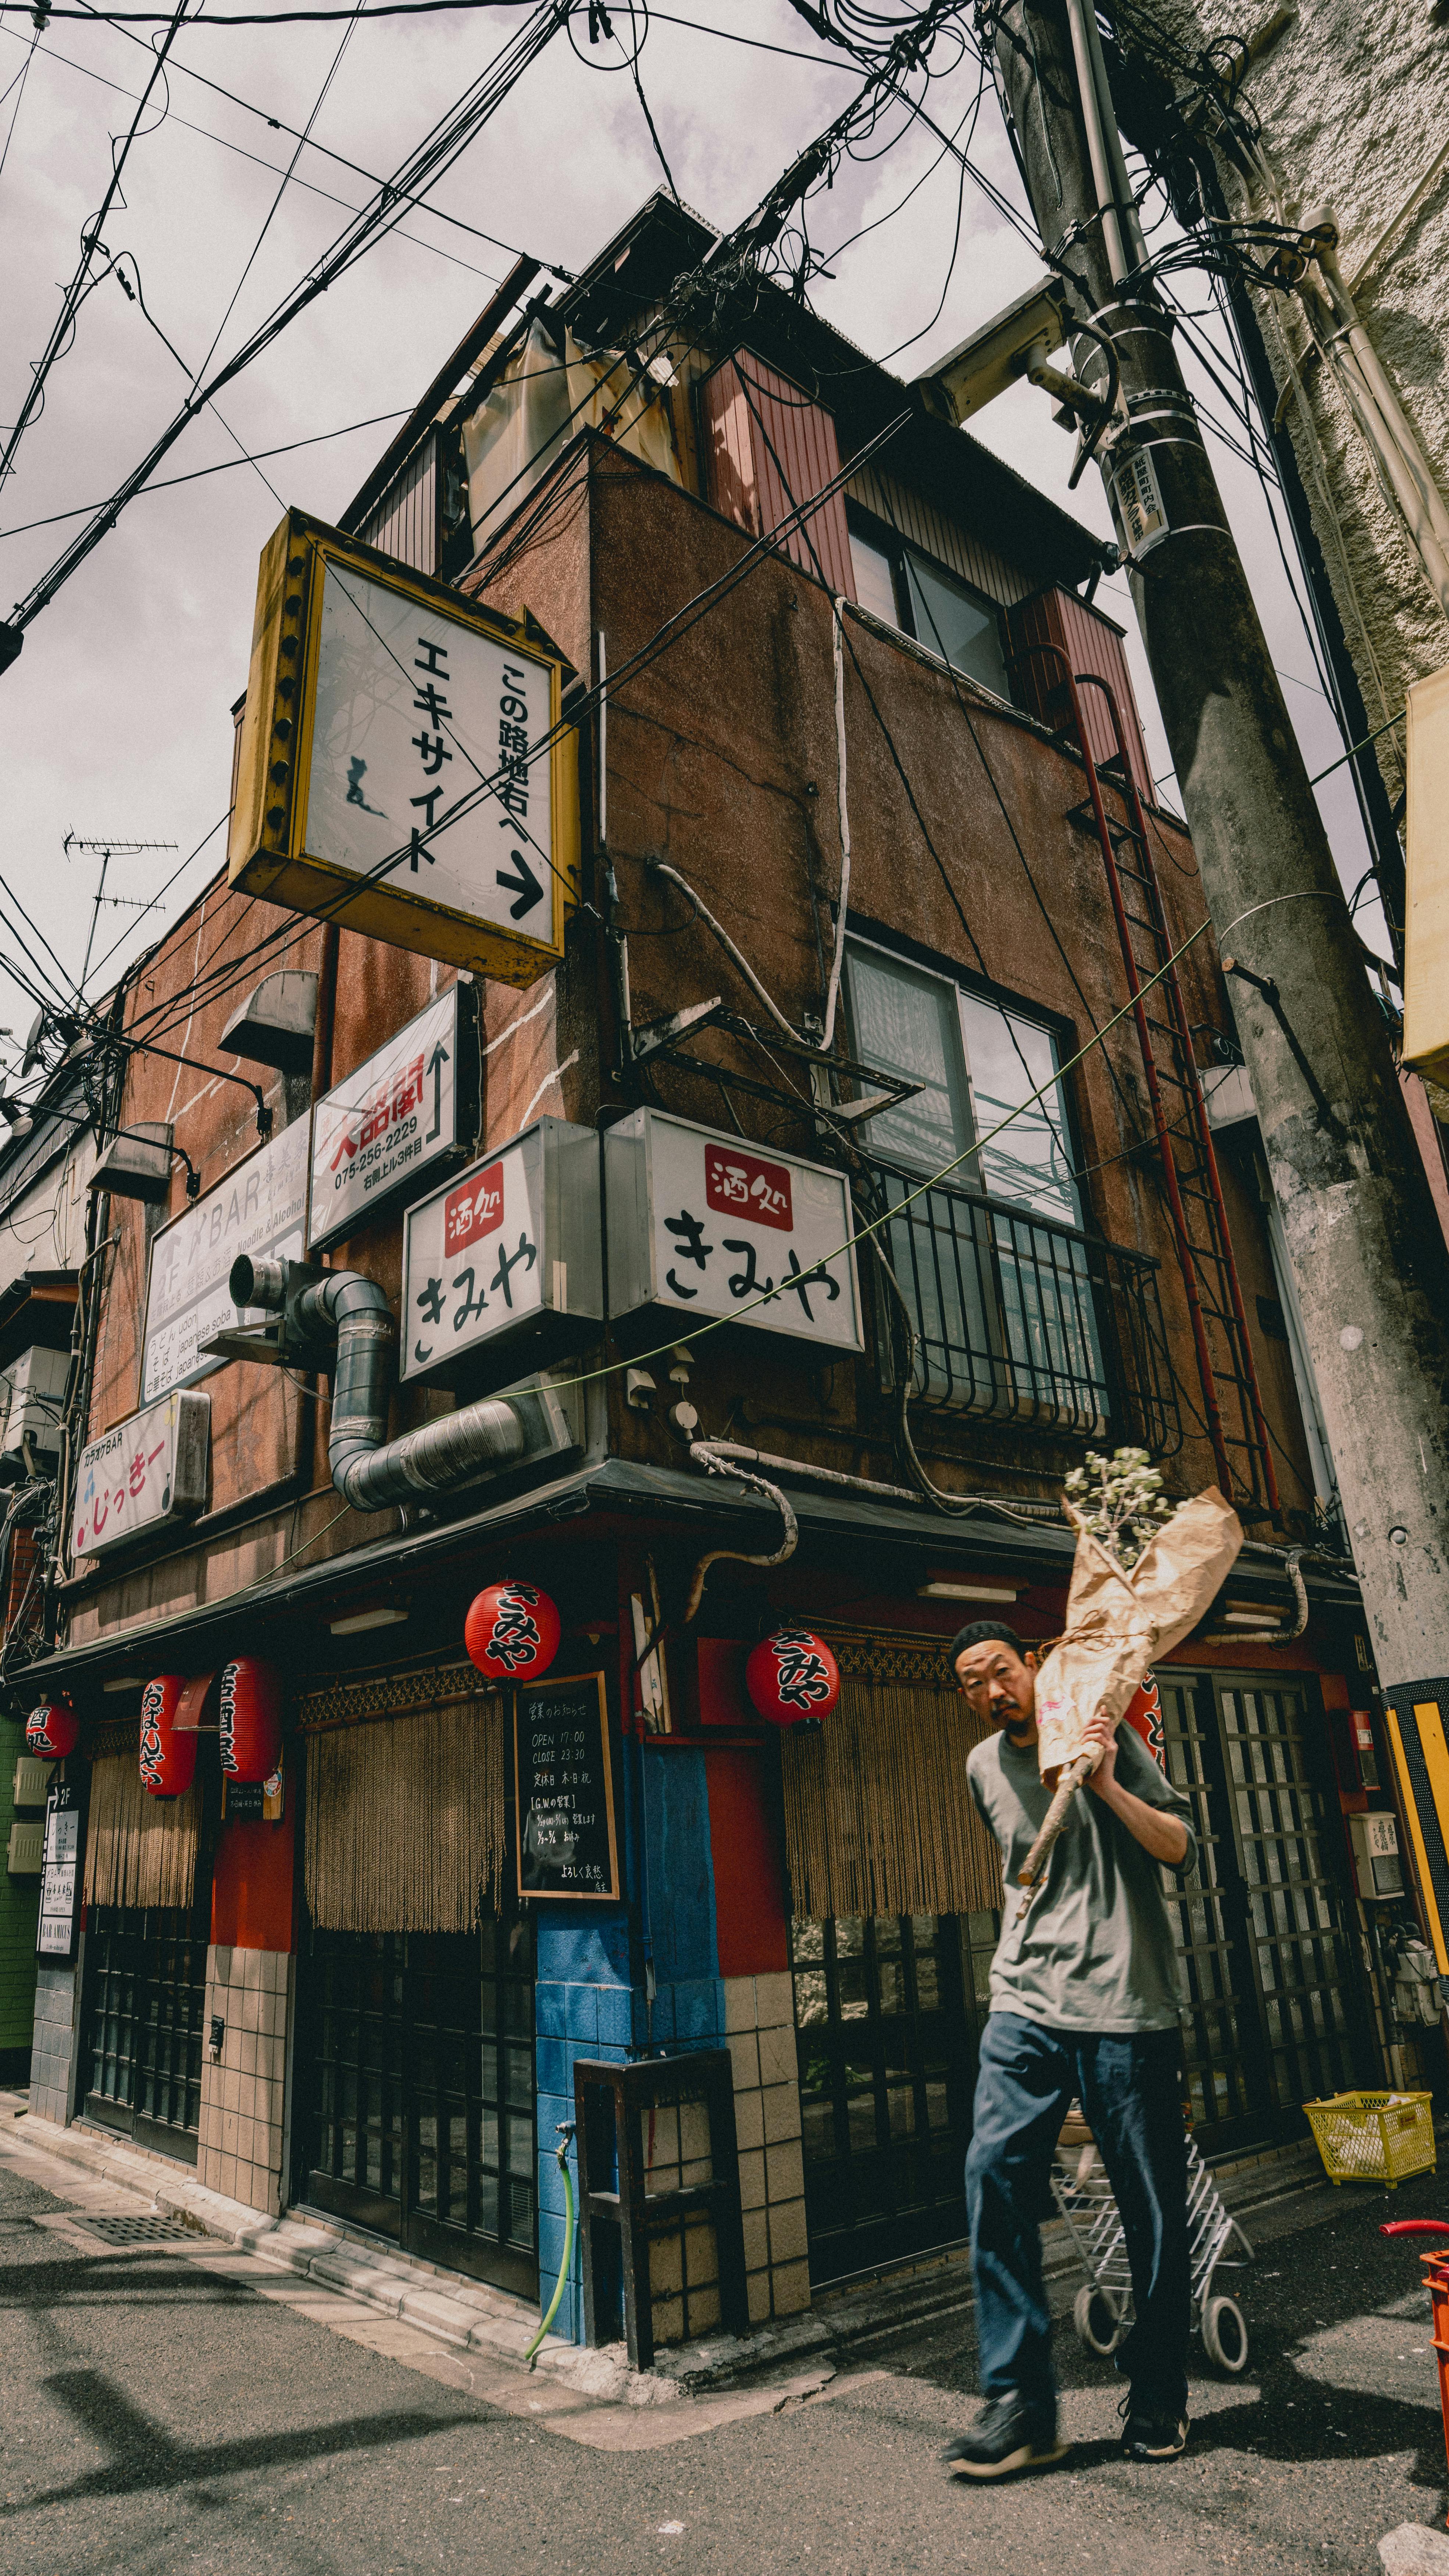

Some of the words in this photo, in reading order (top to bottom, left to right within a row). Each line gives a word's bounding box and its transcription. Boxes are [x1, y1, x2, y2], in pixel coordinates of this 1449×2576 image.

[1134, 457, 1156, 515] 紙屋町町内会
[410, 637, 453, 873] エキサイト
[497, 664, 530, 843] この路地右へ
[335, 1116, 417, 1190] 075-256-2229
[364, 1137, 422, 1191] 右側上ル3件目
[448, 1186, 501, 1240] 酒処
[711, 1161, 788, 1214] 酒処
[238, 1227, 263, 1254] Noodle
[266, 1219, 271, 1234] &
[273, 1192, 305, 1229] Alcohol
[157, 1262, 179, 1303] 2F
[664, 1210, 841, 1323] きみや
[415, 1232, 536, 1363] きみや
[150, 1327, 175, 1356] うどん
[179, 1314, 196, 1334] udon
[153, 1347, 170, 1372] そば
[177, 1324, 210, 1358] japanese
[212, 1309, 231, 1331] soba
[147, 1365, 173, 1396] 中華そば
[84, 1432, 123, 1469] カラオケBAR
[93, 1439, 165, 1535] じっきー
[486, 1582, 540, 1671] きみや
[768, 1630, 830, 1710] きみや
[140, 1683, 165, 1790] おばんざい
[529, 1701, 587, 1721] 営業のお知らせ
[532, 1733, 554, 1747] OPEN
[560, 1731, 584, 1744] 17:00
[533, 1751, 556, 1764] CLOSE
[561, 1749, 584, 1760] 23:30
[60, 1788, 71, 1805] 2F
[534, 1772, 554, 1787] 定休日
[564, 1831, 580, 1842] お休み
[572, 1813, 595, 1825] 営業します
[561, 1864, 603, 1880] よろしく哀愁
[42, 1923, 52, 1938] BAR
[53, 1924, 70, 1940] AMICUS
